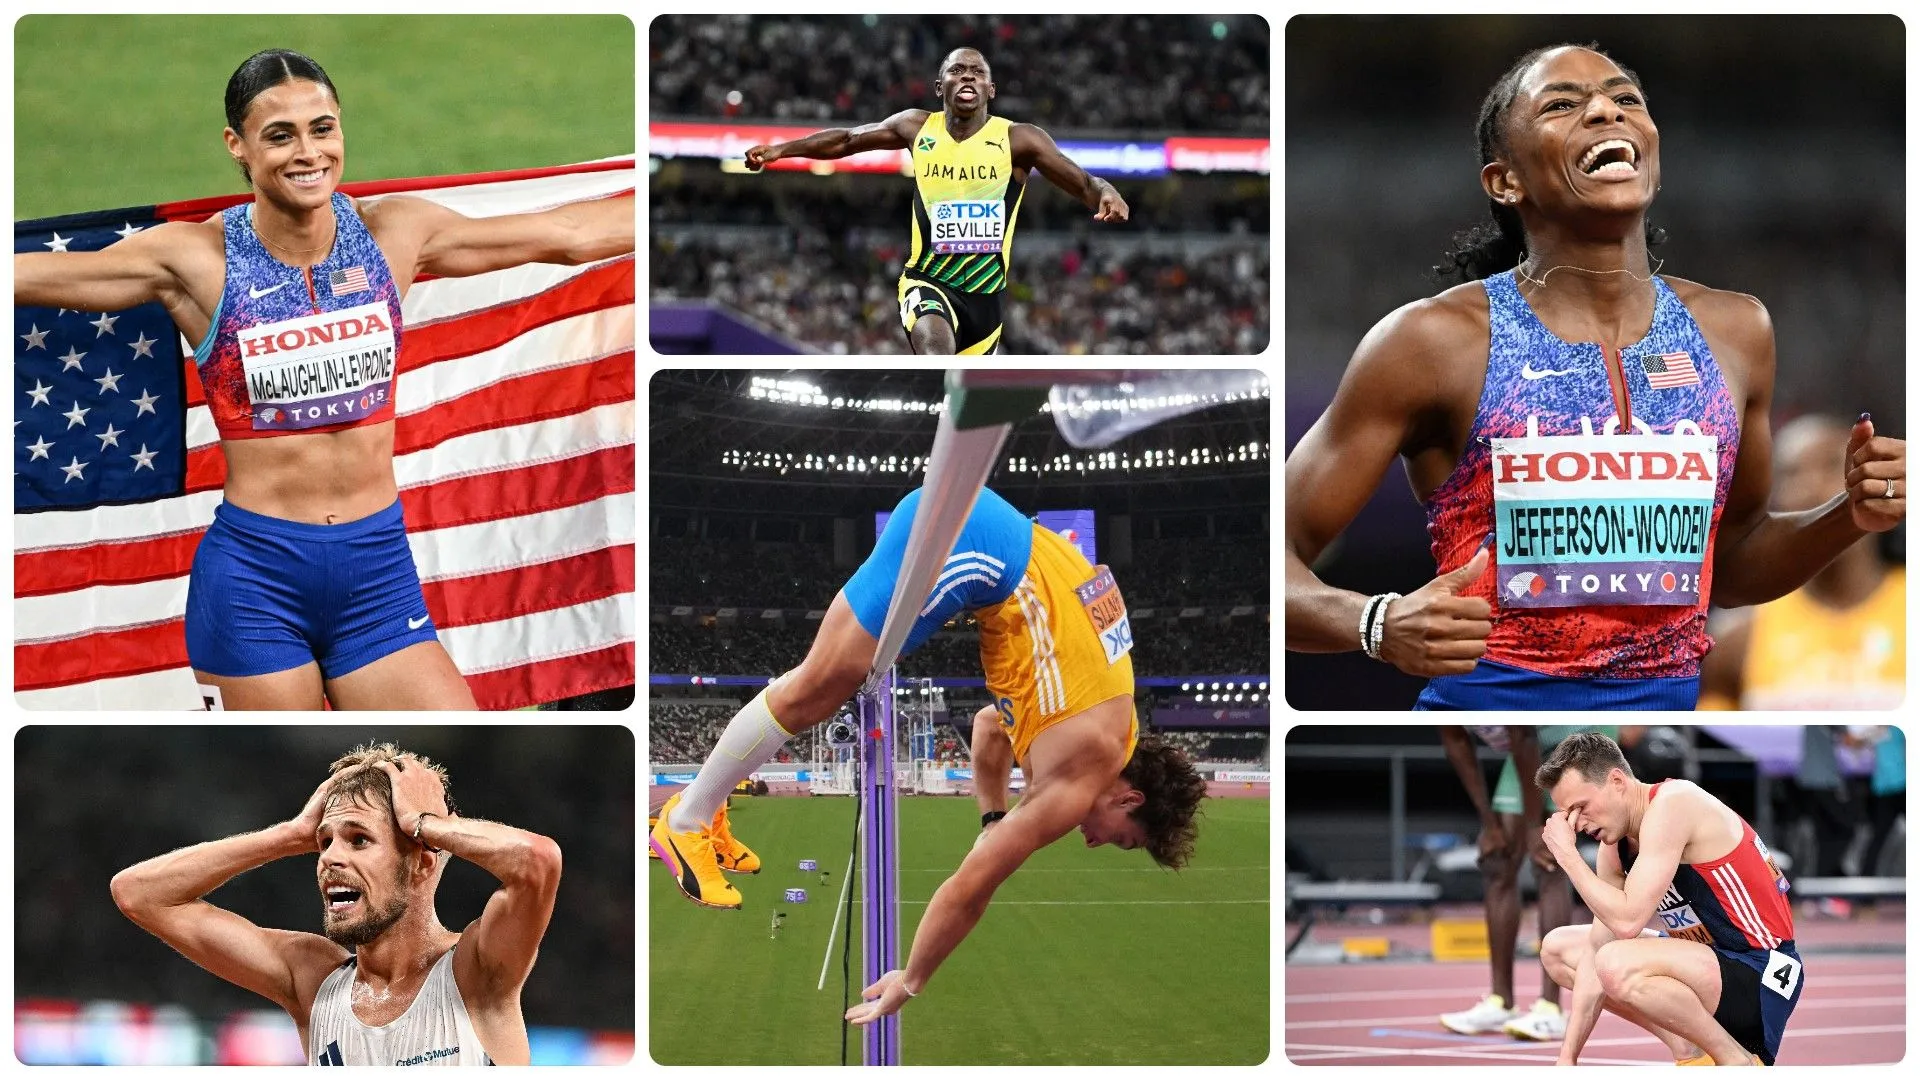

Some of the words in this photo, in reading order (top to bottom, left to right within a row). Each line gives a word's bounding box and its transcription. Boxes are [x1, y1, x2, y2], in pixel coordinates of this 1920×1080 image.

[924, 163, 998, 181] JAMAICA
[951, 203, 1000, 218] TDK
[936, 222, 1001, 239] SEVILLE
[243, 313, 389, 358] HONDA
[251, 347, 391, 400] McLAUGHLIN-LEVRONE
[1497, 452, 1713, 483] HONDA
[1505, 504, 1709, 557] JEFFERSON-WOODEN
[1105, 619, 1132, 656] DK
[1659, 908, 1696, 929] DK
[1772, 963, 1793, 990] 4
[396, 1055, 423, 1066] Crédit
[433, 1046, 460, 1059] Mutue
